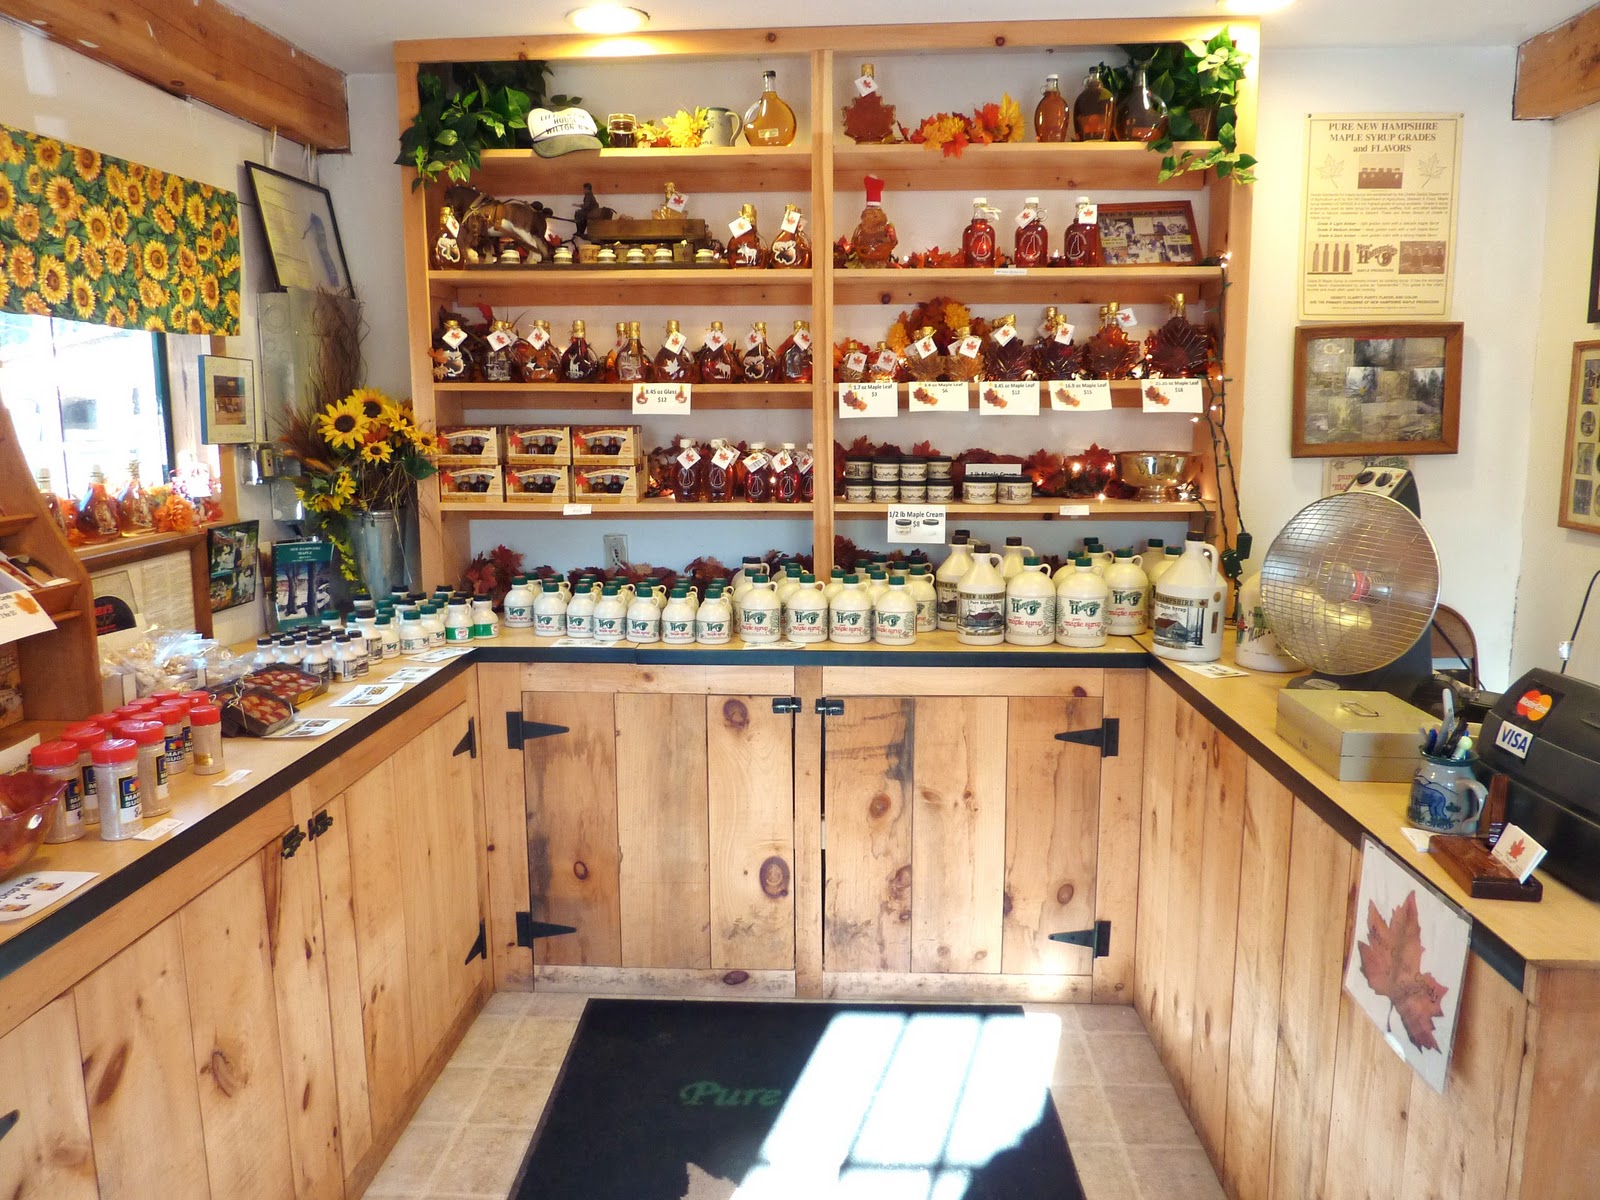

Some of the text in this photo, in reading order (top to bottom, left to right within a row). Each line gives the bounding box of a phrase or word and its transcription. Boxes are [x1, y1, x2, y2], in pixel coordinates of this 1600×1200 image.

[1329, 122, 1438, 130] PURE NEW HAMPSHIRE
[1398, 133, 1436, 141] GRADES
[1371, 144, 1412, 152] FLAVORS
[906, 511, 925, 519] Maple
[1502, 725, 1528, 753] VISA
[680, 1081, 782, 1106] Pure
